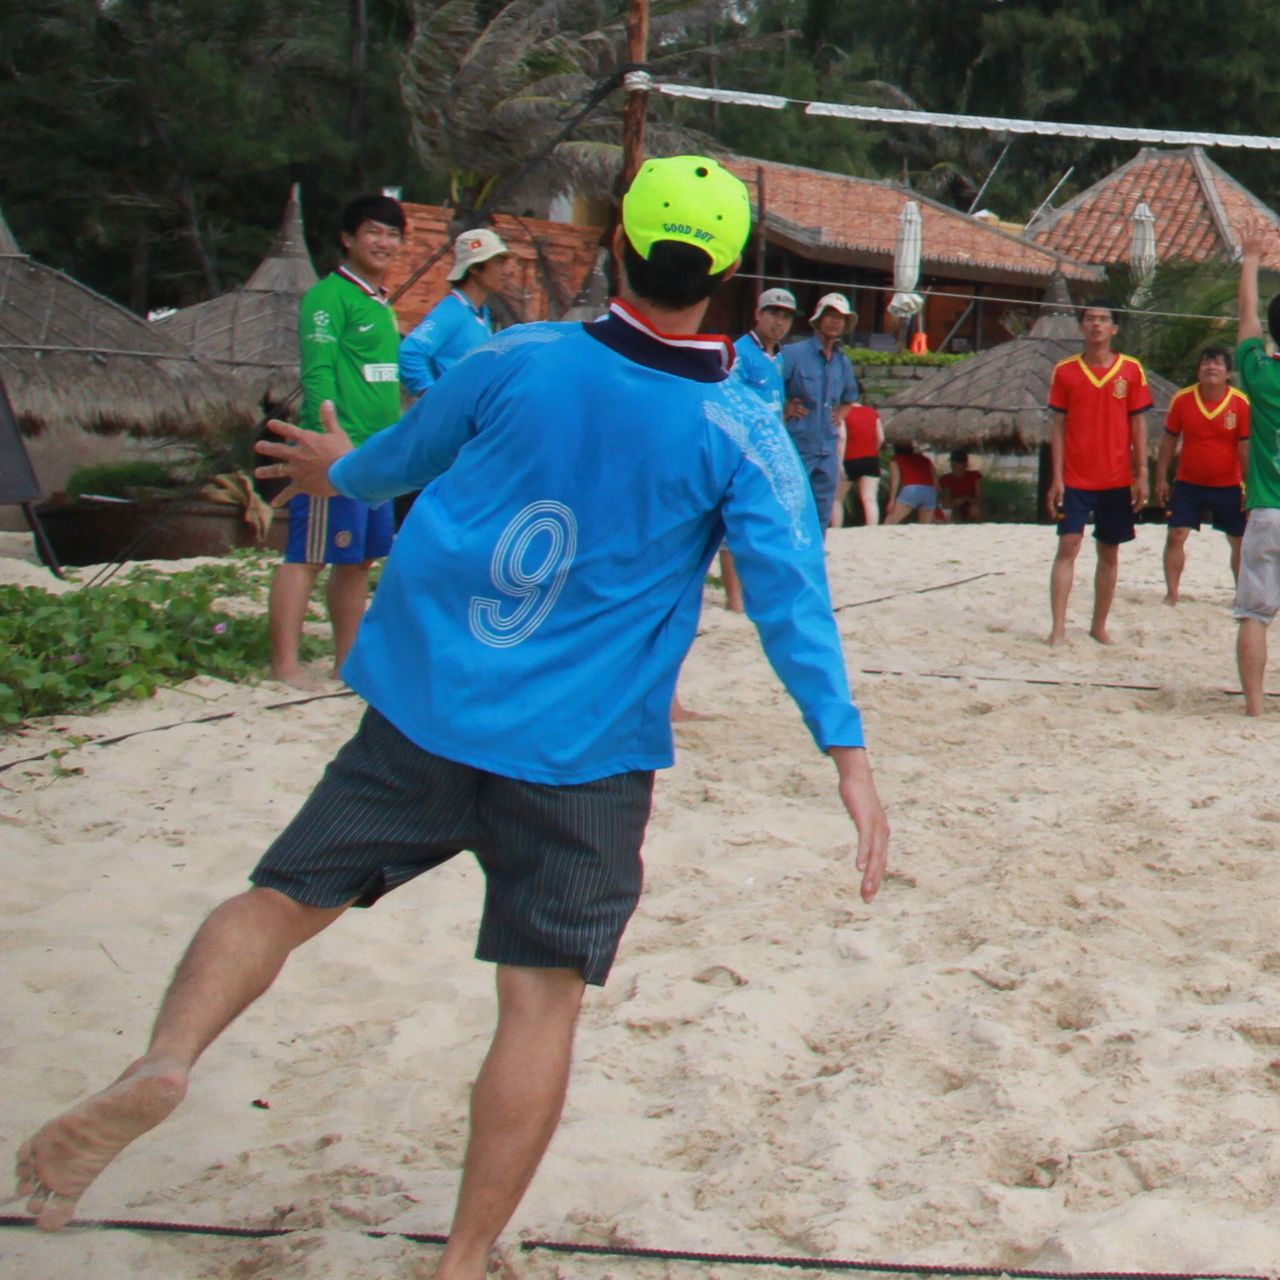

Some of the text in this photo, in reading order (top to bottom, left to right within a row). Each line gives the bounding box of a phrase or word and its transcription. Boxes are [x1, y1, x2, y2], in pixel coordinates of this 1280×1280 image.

[663, 223, 715, 242] GOOD BOY
[469, 500, 578, 648] 9
